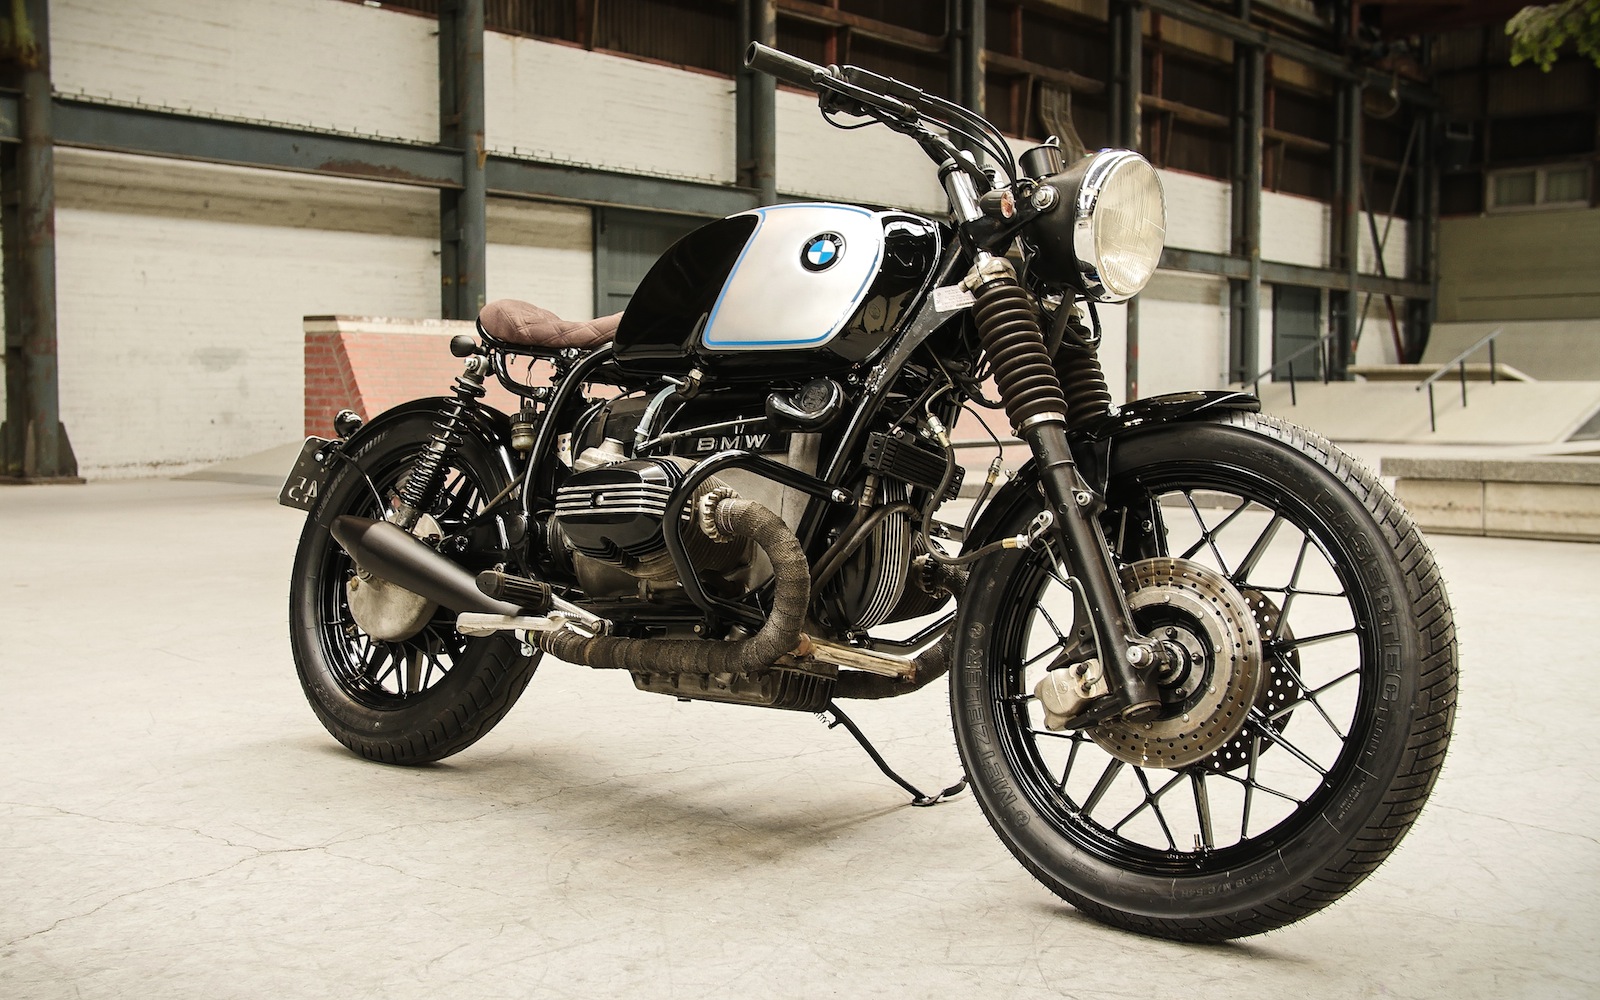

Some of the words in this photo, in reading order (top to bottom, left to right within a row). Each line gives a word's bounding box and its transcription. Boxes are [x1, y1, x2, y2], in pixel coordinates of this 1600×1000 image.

[808, 233, 842, 247] BMW
[696, 433, 767, 452] BMW
[1313, 488, 1403, 703] LASERTEC
[963, 648, 1018, 809] METZELER
